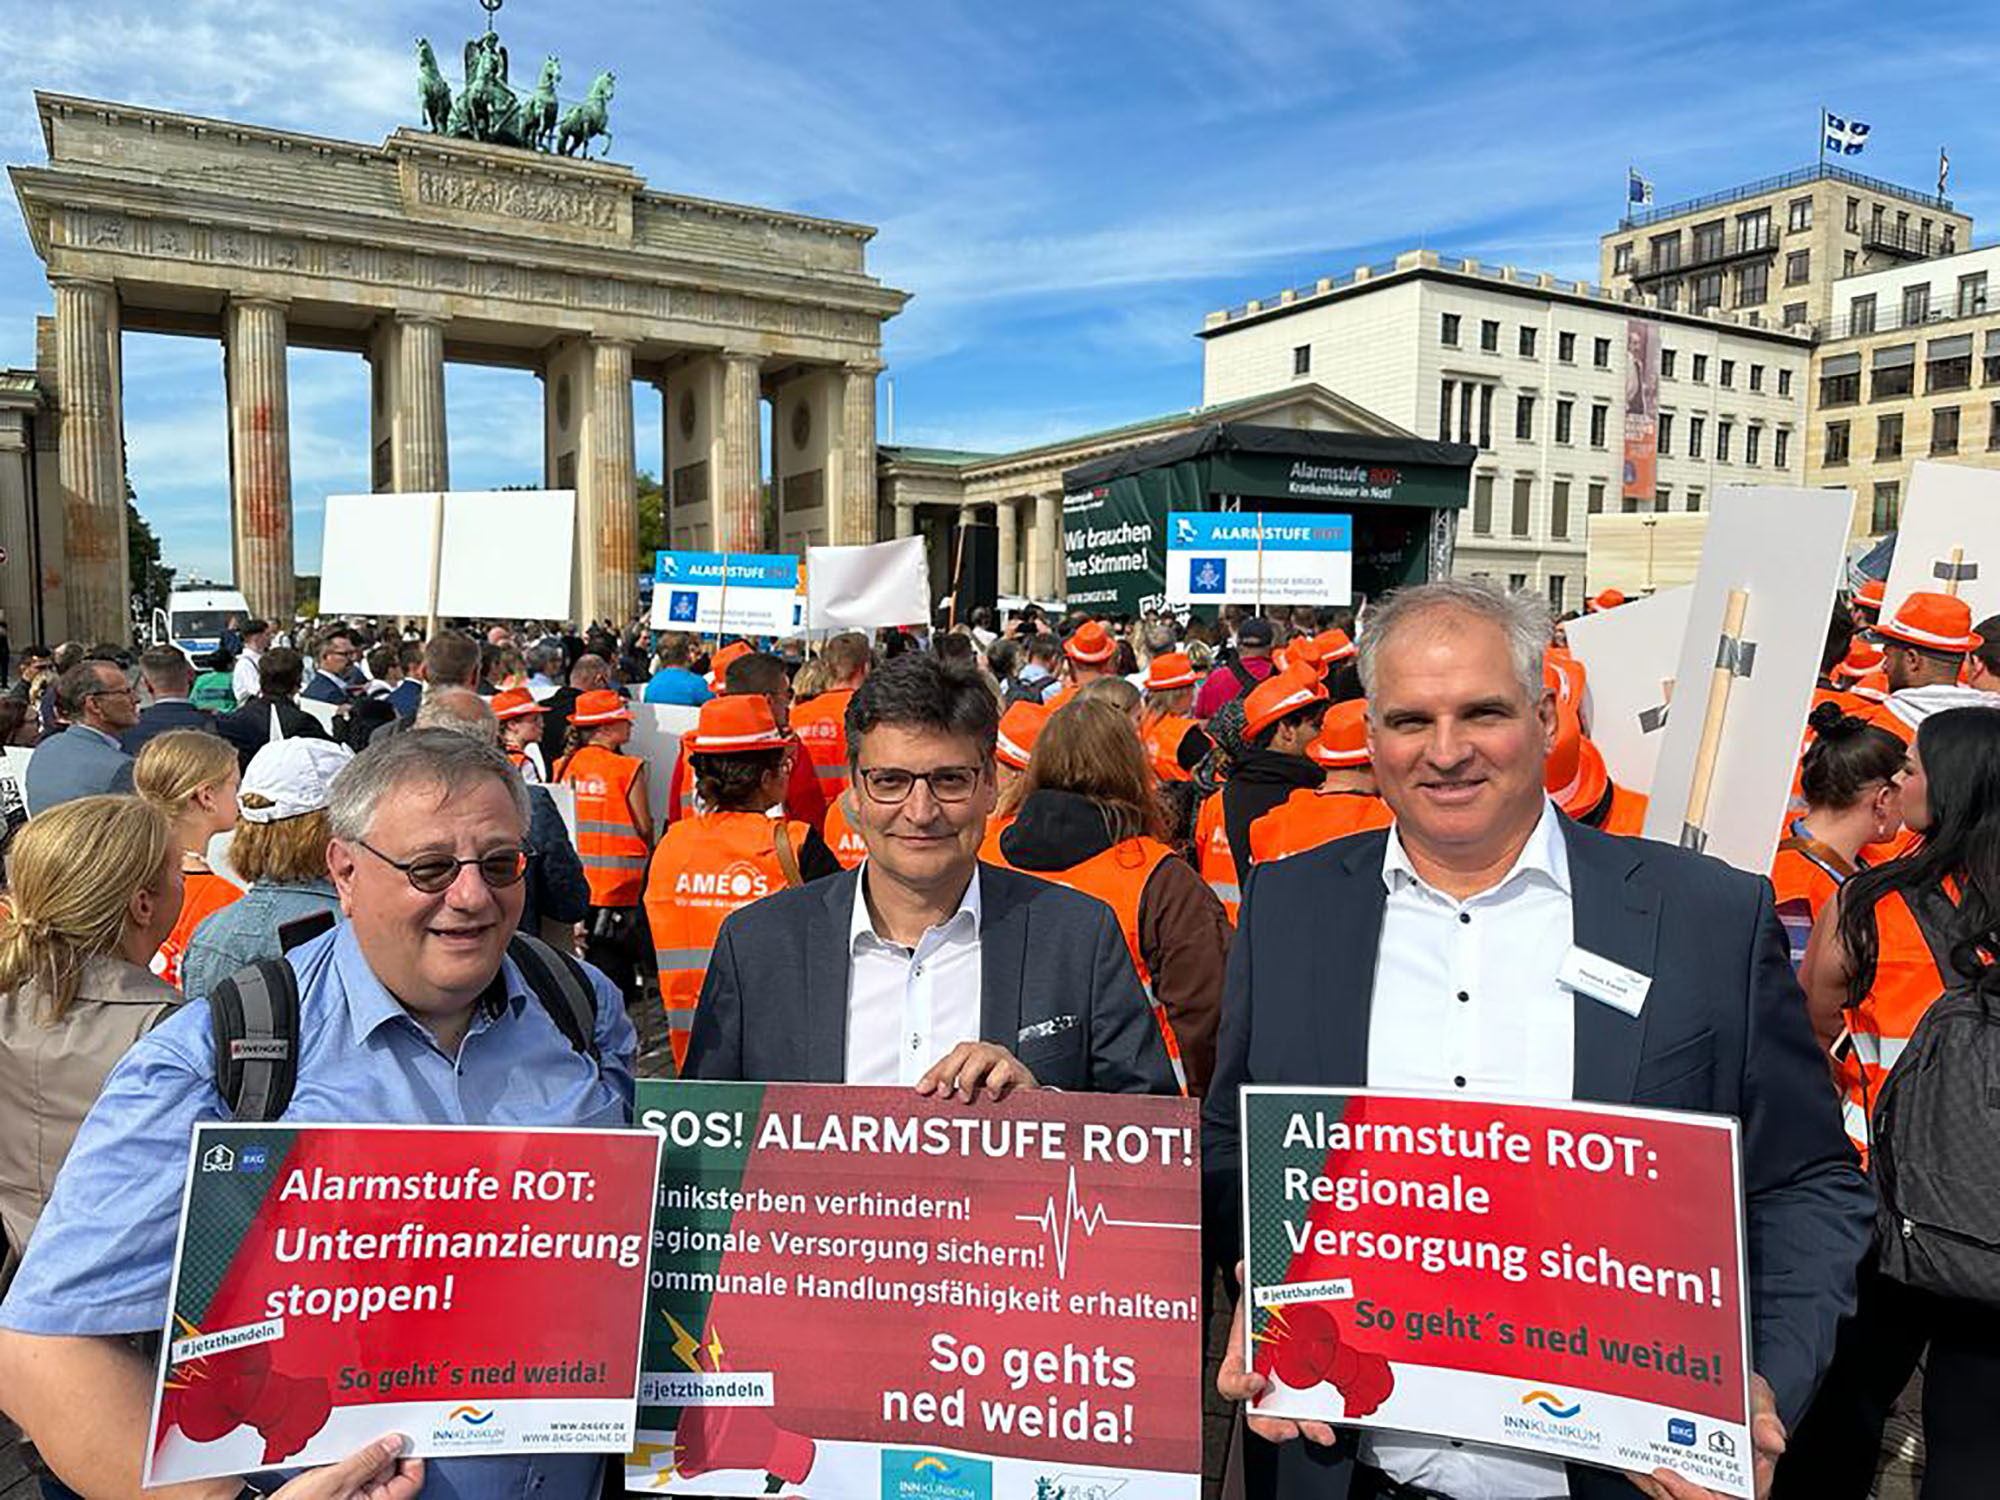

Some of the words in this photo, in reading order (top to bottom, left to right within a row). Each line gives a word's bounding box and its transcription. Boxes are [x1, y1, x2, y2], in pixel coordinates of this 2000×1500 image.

[1290, 462, 1368, 482] Alarmstufe
[1370, 487, 1392, 499] Not!
[1064, 529, 1086, 551] Wir
[1087, 521, 1152, 548] brauchen
[1088, 547, 1148, 575] Stimme!
[675, 873, 769, 896] AMEOS
[641, 1109, 743, 1149] SOS!
[758, 1113, 1066, 1160] ALARMSTUFE
[1083, 1124, 1193, 1167] ROT!
[1282, 1112, 1532, 1163] Alarmstufe
[1547, 1129, 1659, 1180] ROT:
[279, 1167, 500, 1201] Alarmstufe
[512, 1170, 596, 1202] ROT:
[660, 1184, 806, 1214] iniksterben
[814, 1193, 971, 1221] verhindern!
[1284, 1167, 1490, 1214] Regionale
[274, 1223, 642, 1267] Unterfinanzierung
[652, 1226, 761, 1254] egionale
[769, 1231, 928, 1264] Versorgung
[936, 1239, 1045, 1269] sichern!
[1283, 1219, 1528, 1280] Versorgung
[1540, 1242, 1723, 1308] sichern!
[265, 1274, 454, 1321] stoppen!
[650, 1271, 788, 1296] ommunale
[797, 1275, 1061, 1314] Handlungsfähigkeit
[1069, 1290, 1198, 1321] erhalten!
[1262, 1284, 1345, 1302] #jetzthandeln
[181, 1326, 275, 1356] #jetzthandeln
[1355, 1300, 1396, 1331] So
[1525, 1320, 1589, 1356] ned
[1598, 1338, 1722, 1386] weida!
[337, 1366, 372, 1392] So
[469, 1359, 516, 1384] ned
[523, 1359, 606, 1384] weida!
[930, 1334, 987, 1376] So
[1003, 1343, 1137, 1391] gehts
[643, 1380, 765, 1400] #jetzthandeln
[883, 1388, 966, 1428] ned
[981, 1396, 1135, 1445] weida!
[1503, 1415, 1602, 1444] INNKLINIKUM
